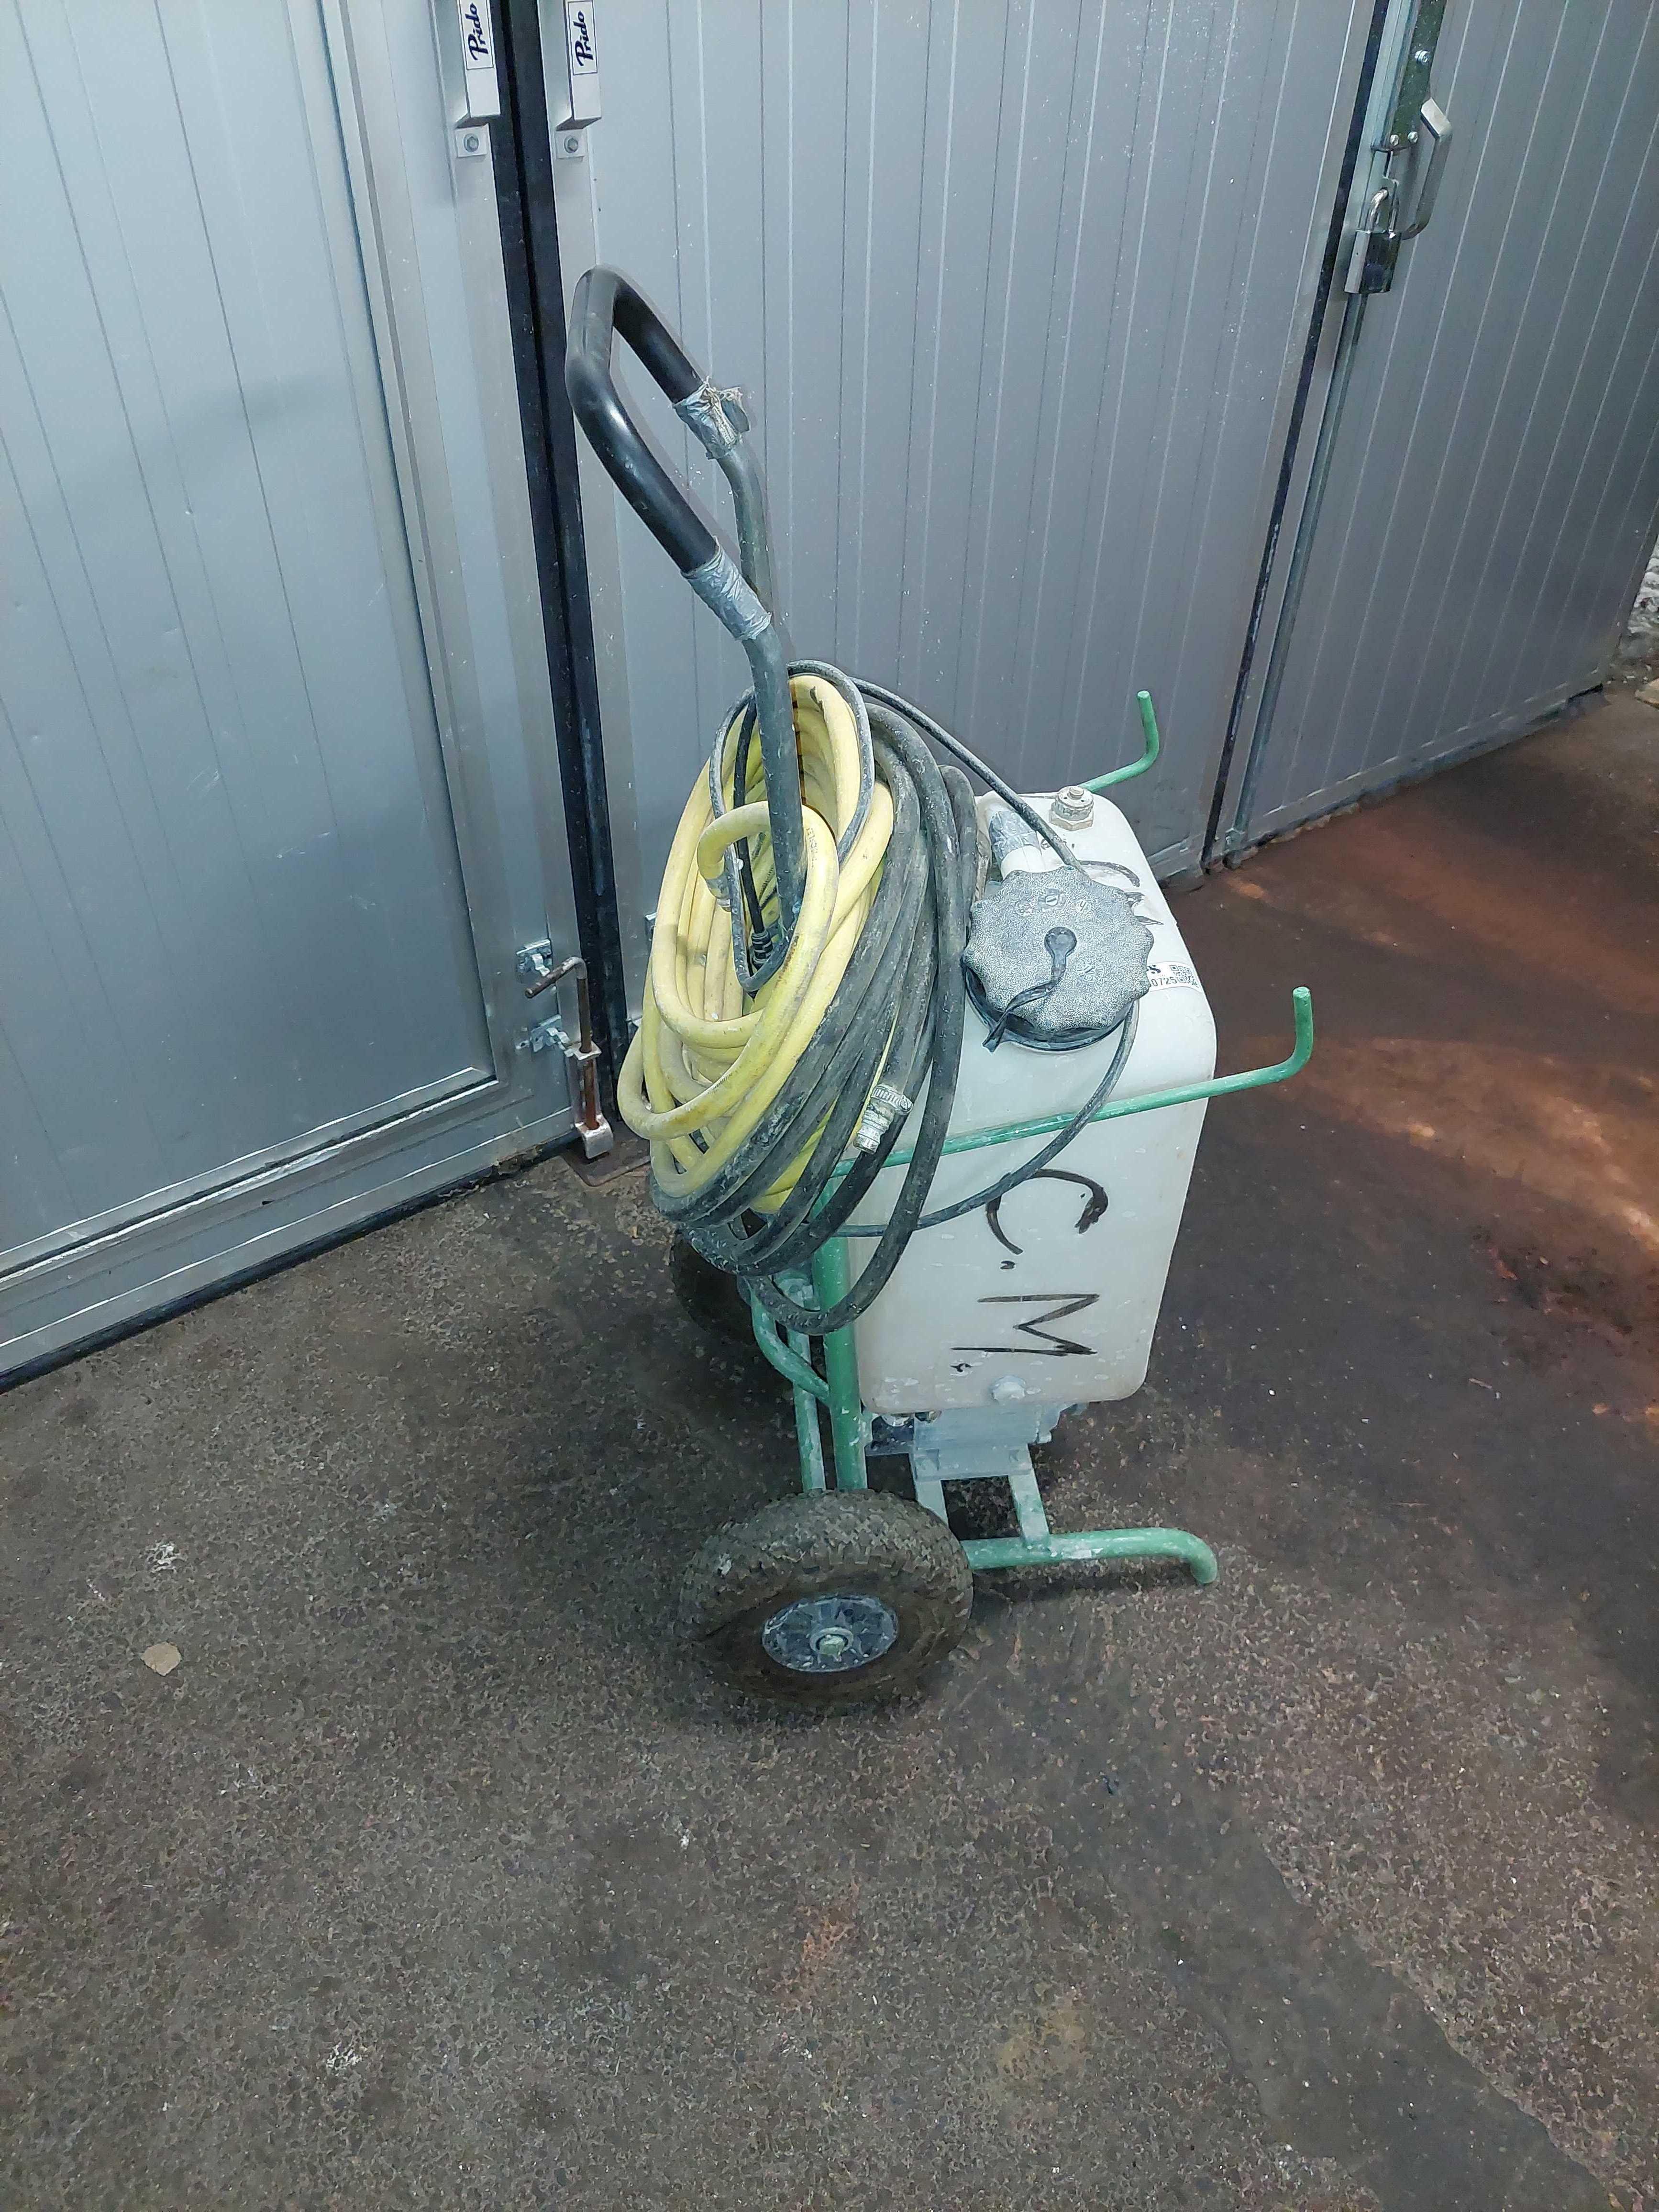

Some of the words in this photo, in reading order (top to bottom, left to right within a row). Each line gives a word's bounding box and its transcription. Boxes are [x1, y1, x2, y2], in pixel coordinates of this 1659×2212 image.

[465, 3, 489, 61] Prido
[573, 11, 594, 66] Prido
[1149, 977, 1177, 987] 0725
